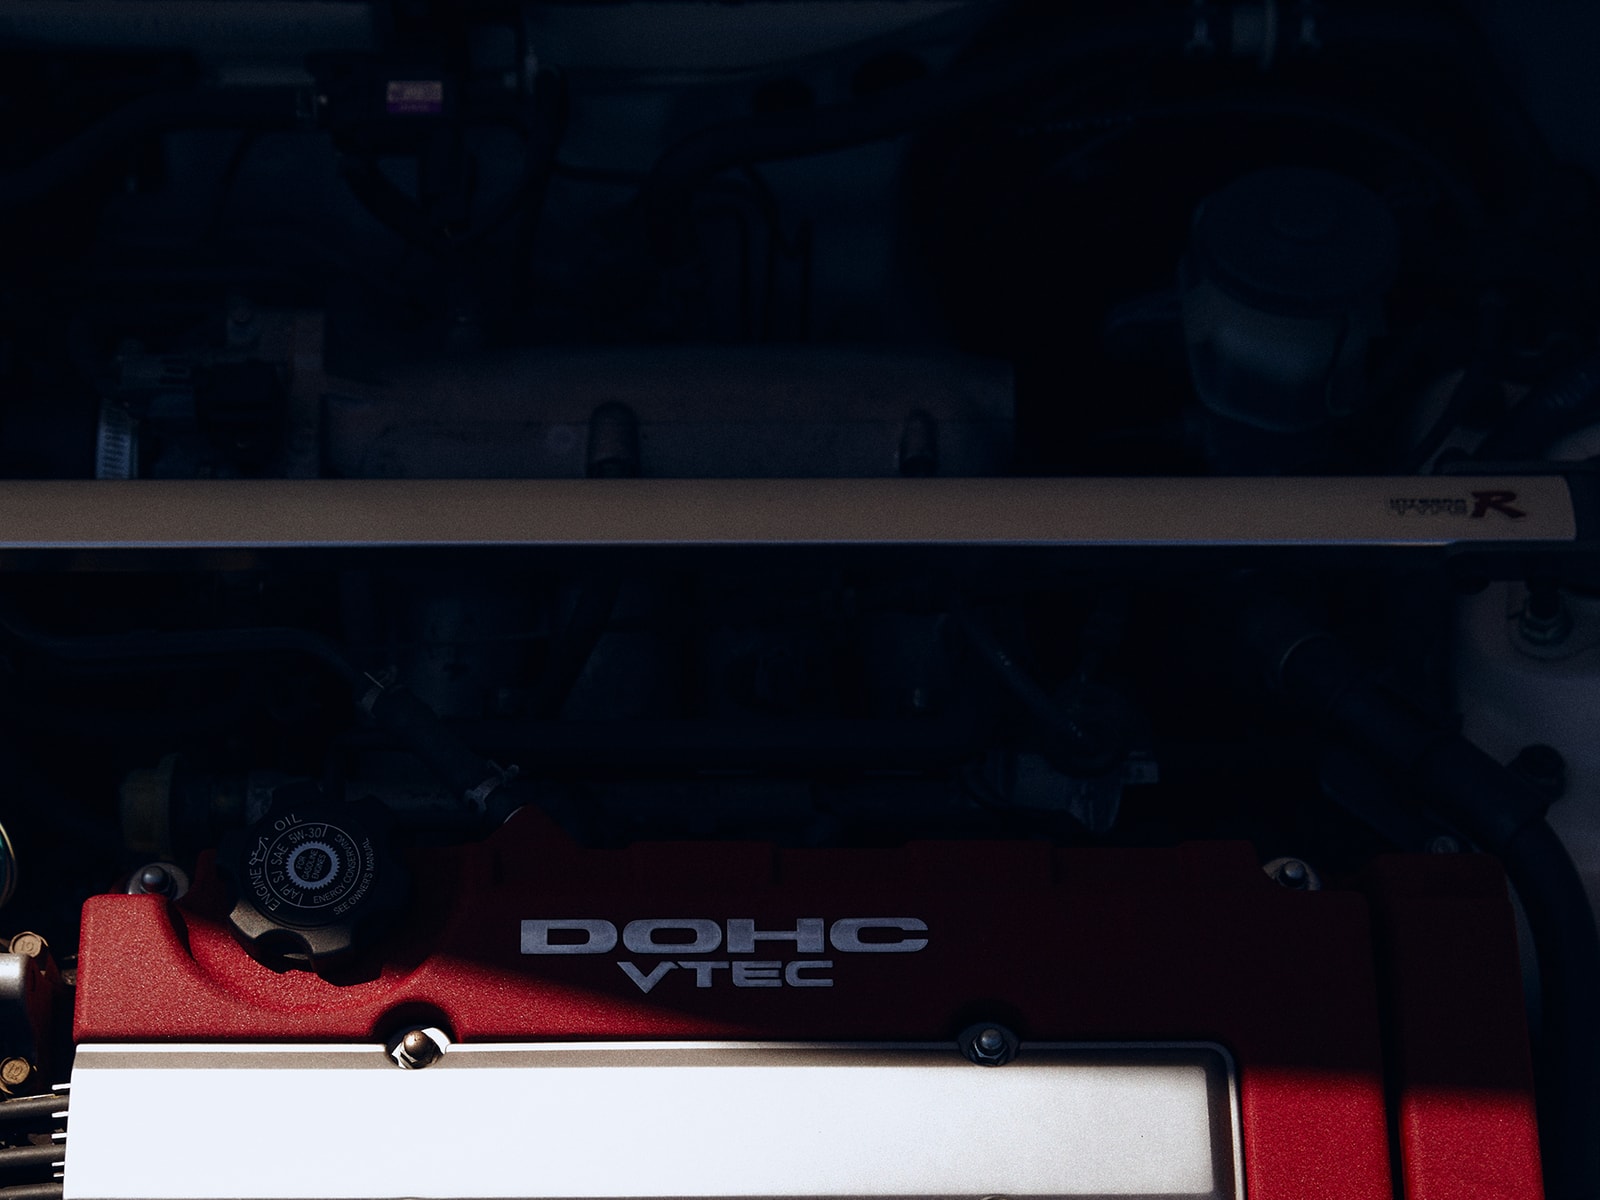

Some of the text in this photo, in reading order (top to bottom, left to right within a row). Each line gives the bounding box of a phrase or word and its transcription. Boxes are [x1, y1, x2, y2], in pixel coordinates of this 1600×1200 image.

[1471, 490, 1527, 518] R
[249, 814, 303, 911] ENGINE OIL
[270, 827, 322, 899] API SJ SAE 5W-30
[313, 834, 357, 904] ENERGY CONSERVING
[333, 902, 351, 915] SEE
[521, 917, 929, 954] DOHC
[617, 960, 834, 994] VTEC
